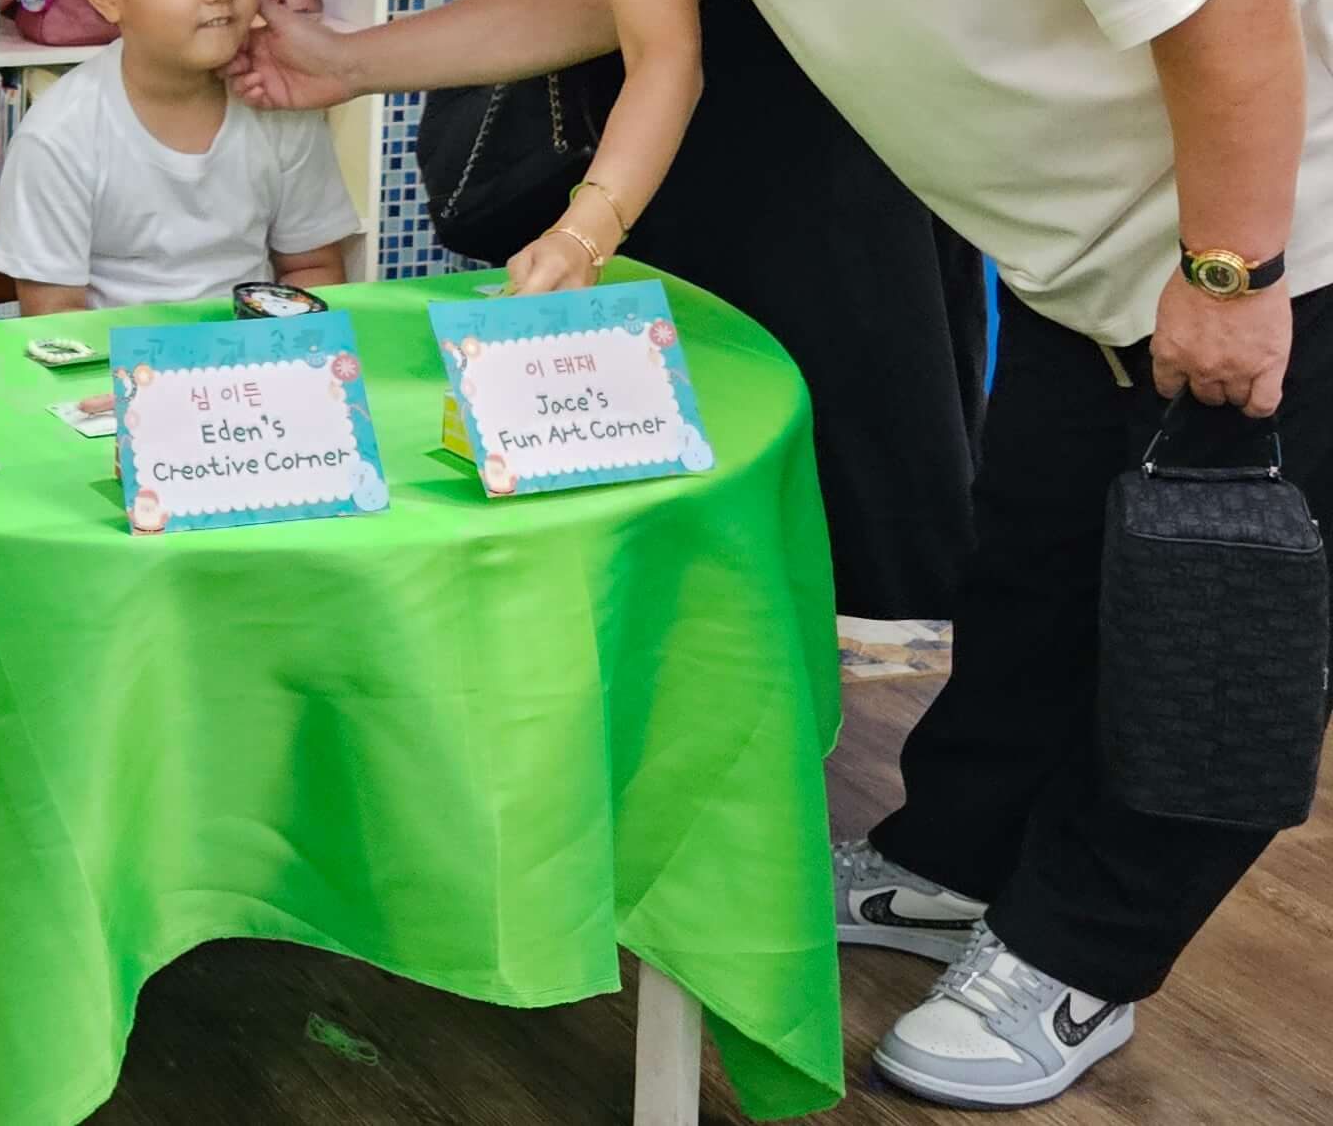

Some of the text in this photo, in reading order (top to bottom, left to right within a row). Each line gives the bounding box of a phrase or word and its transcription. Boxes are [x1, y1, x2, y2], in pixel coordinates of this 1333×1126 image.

[525, 359, 545, 378] 이
[190, 381, 262, 412] 심 이든
[535, 387, 609, 416] Jace's
[201, 415, 286, 444] Eden's
[498, 416, 667, 452] Fun Art Corner
[153, 448, 351, 482] Creative Corner
